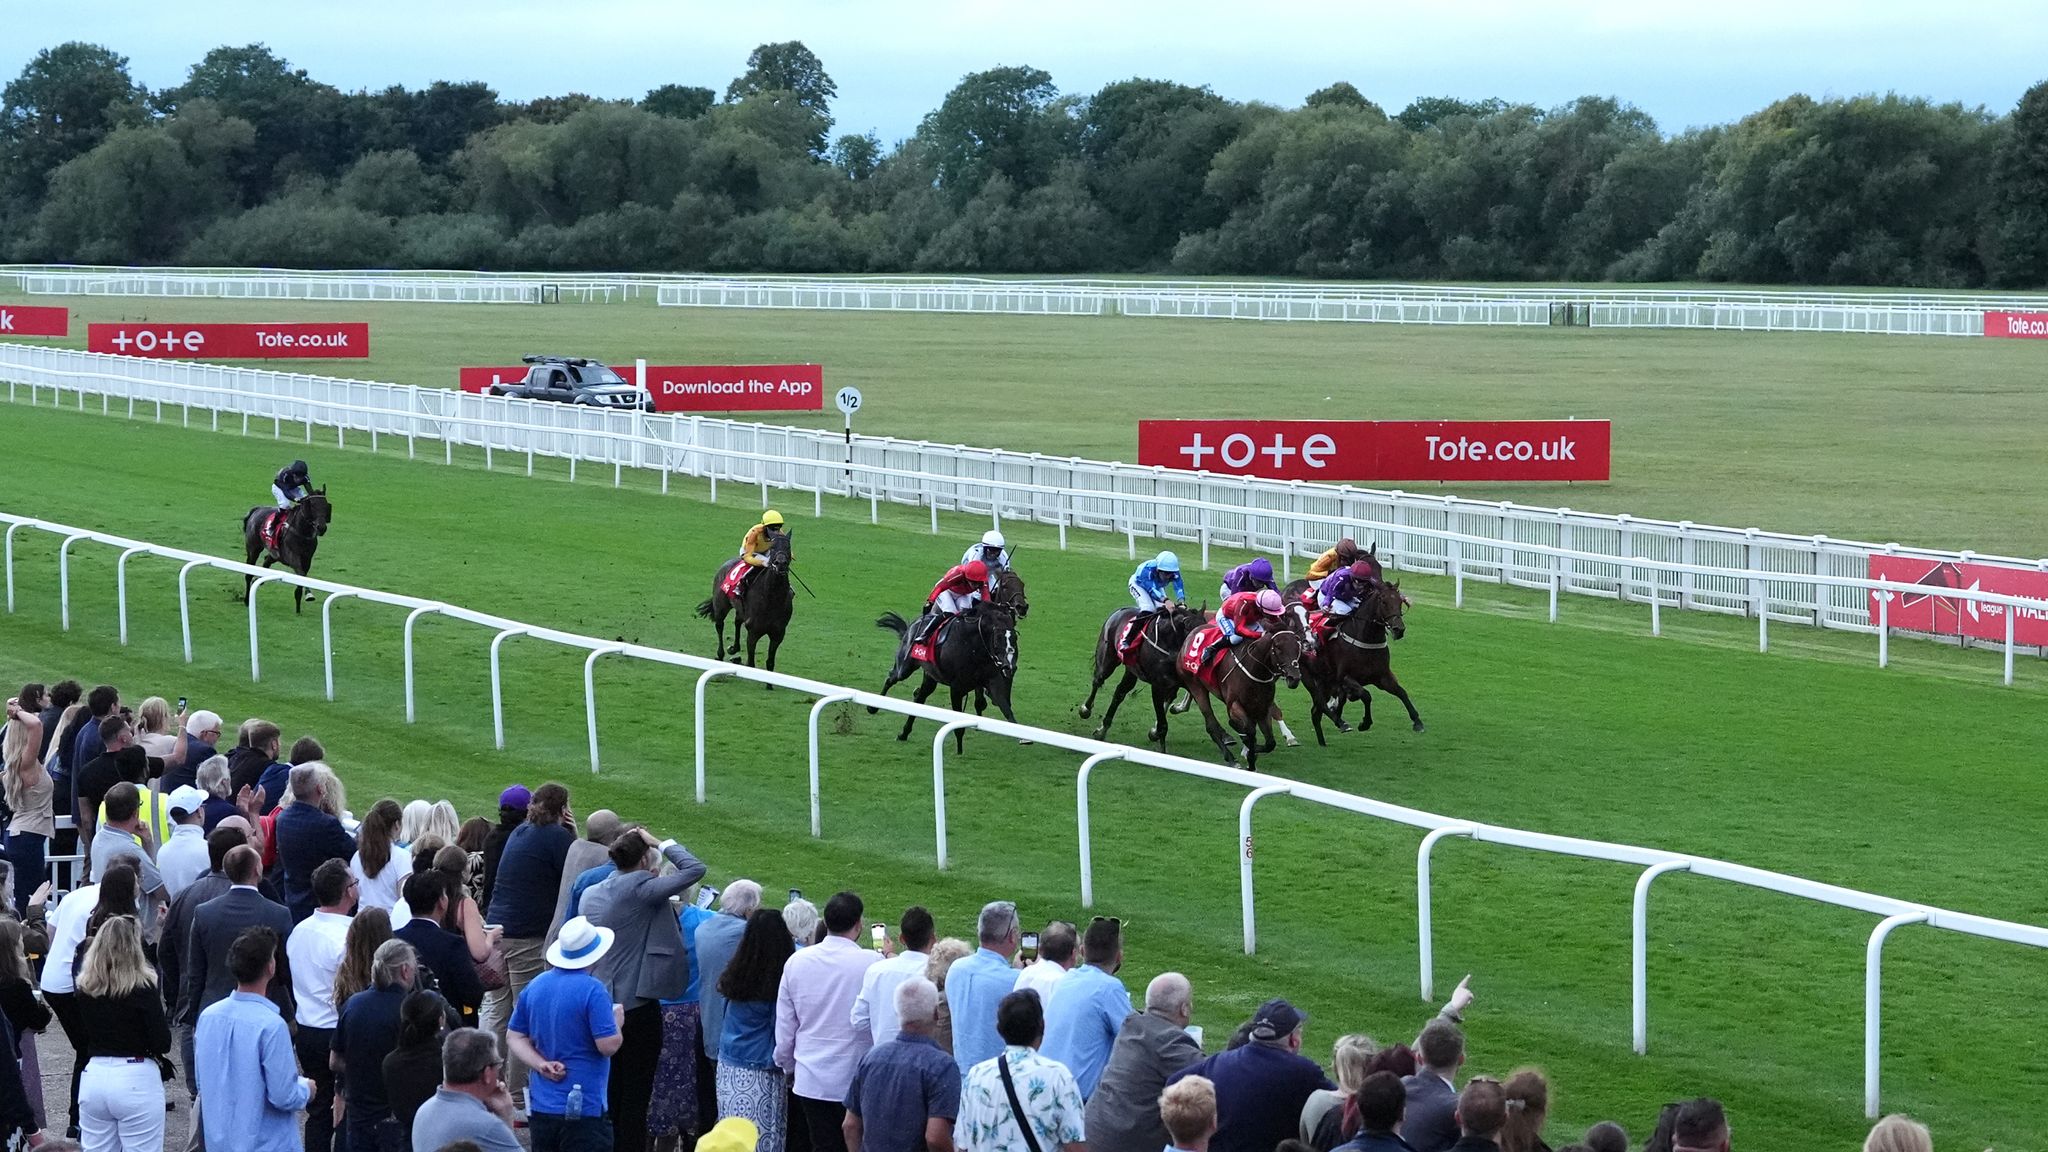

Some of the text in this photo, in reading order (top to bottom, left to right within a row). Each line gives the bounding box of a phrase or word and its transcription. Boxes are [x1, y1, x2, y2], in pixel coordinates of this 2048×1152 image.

[256, 331, 348, 348] Tote.co.uk
[663, 378, 813, 396] Download the App
[840, 392, 858, 408] 1/2
[1425, 435, 1576, 462] Tote.co.uk
[1189, 632, 1206, 657] 9
